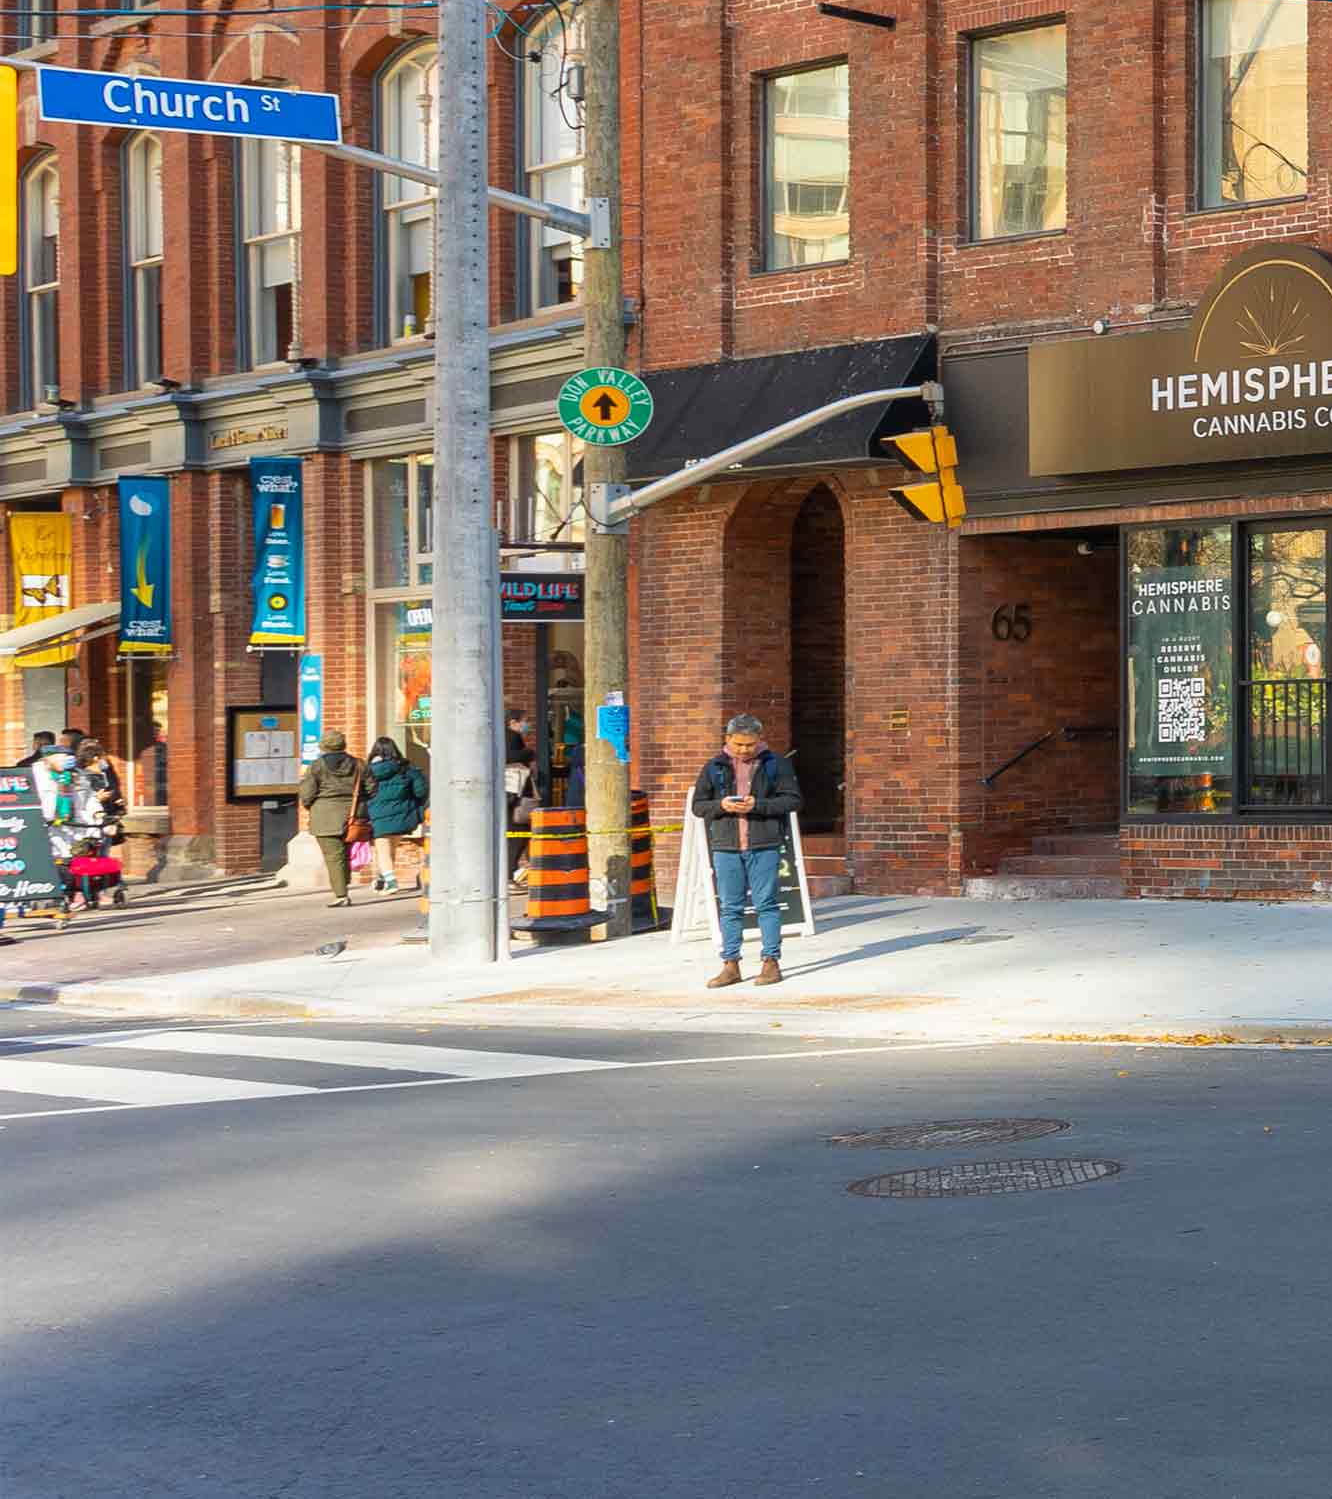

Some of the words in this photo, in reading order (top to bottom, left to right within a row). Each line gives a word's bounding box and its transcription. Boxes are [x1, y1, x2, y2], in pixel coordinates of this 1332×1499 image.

[103, 79, 250, 123] Church
[260, 94, 281, 112] St
[561, 375, 590, 402] DON
[597, 369, 650, 406] VALLEY
[567, 417, 641, 443] PARKWAY
[1193, 408, 1307, 439] CANNABIS
[1138, 578, 1224, 597] HEMISPHERE
[1131, 595, 1231, 615] CANNABIS
[991, 605, 1032, 642] 65
[1157, 654, 1206, 663] CANNABIS
[1160, 644, 1201, 653] RESERVE
[1163, 664, 1199, 673] ONLINE
